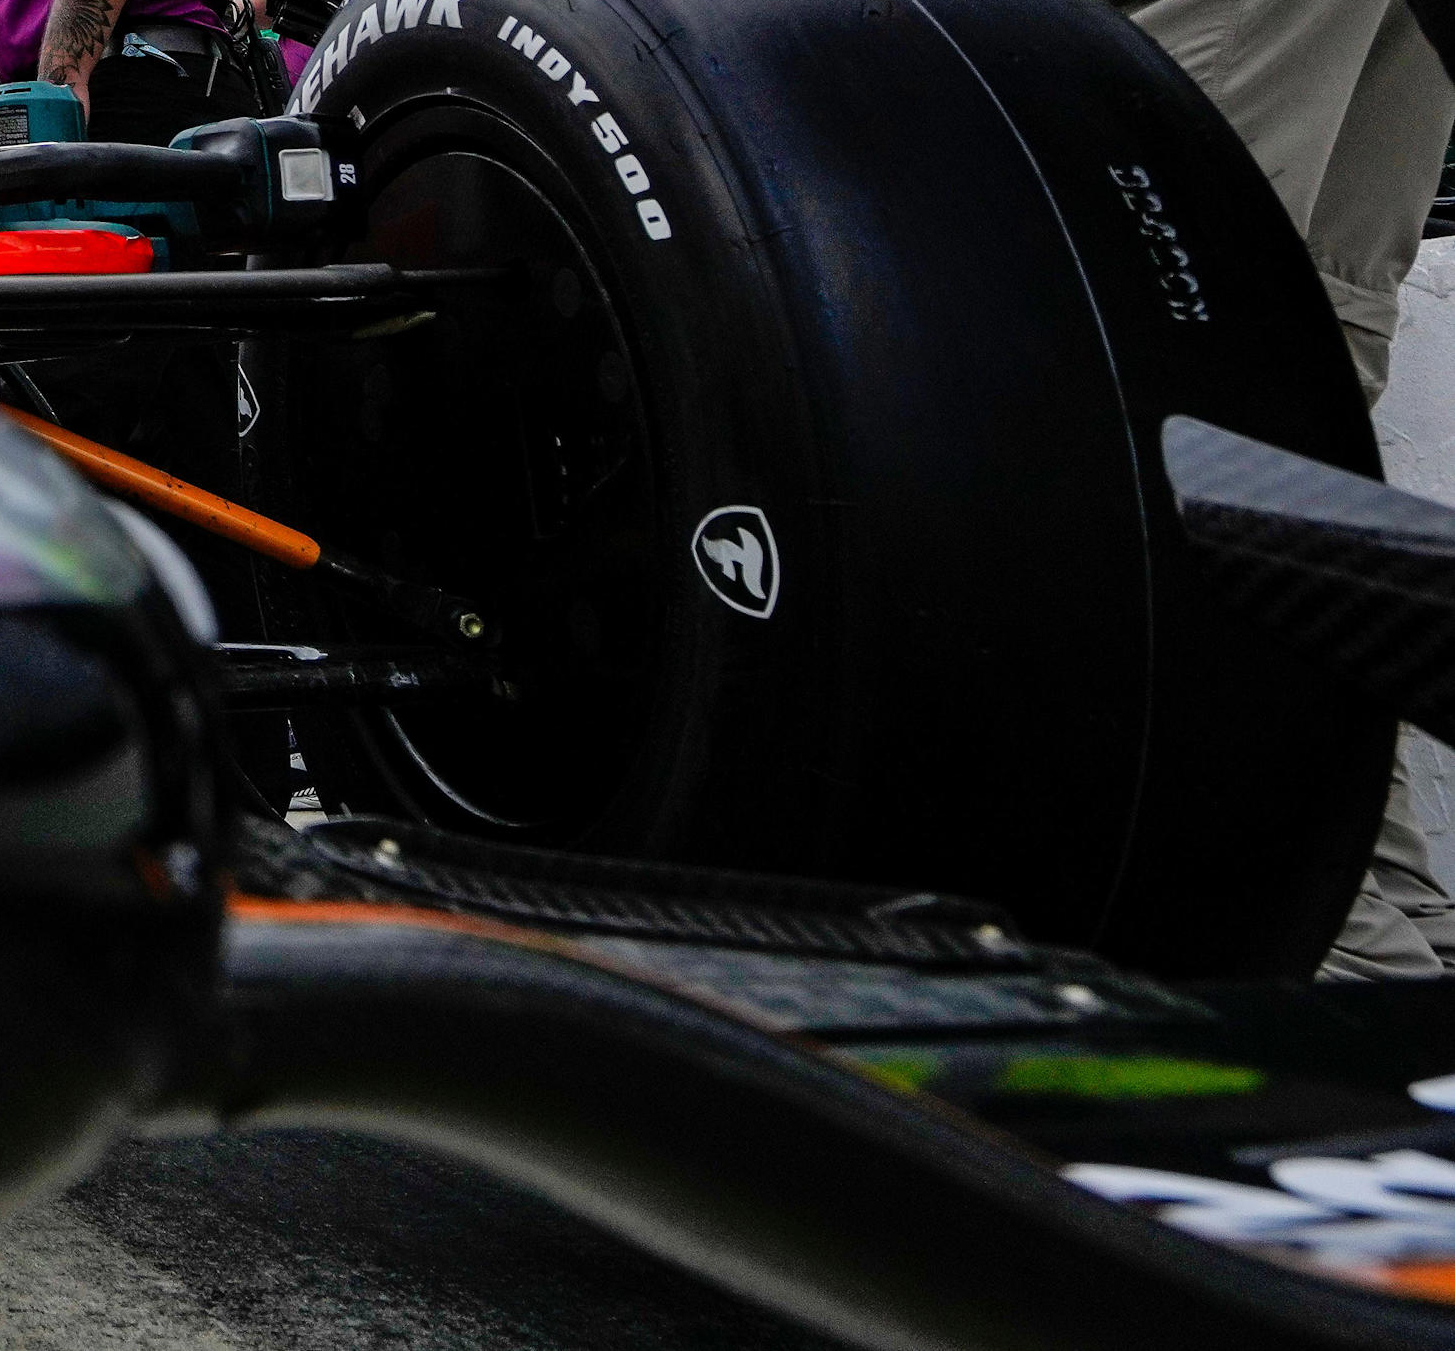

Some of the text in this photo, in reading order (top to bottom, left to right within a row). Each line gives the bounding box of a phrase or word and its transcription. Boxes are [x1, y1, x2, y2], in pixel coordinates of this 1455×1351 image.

[339, 163, 356, 185] 28
[497, 15, 600, 107] INDY
[591, 112, 672, 241] 500
